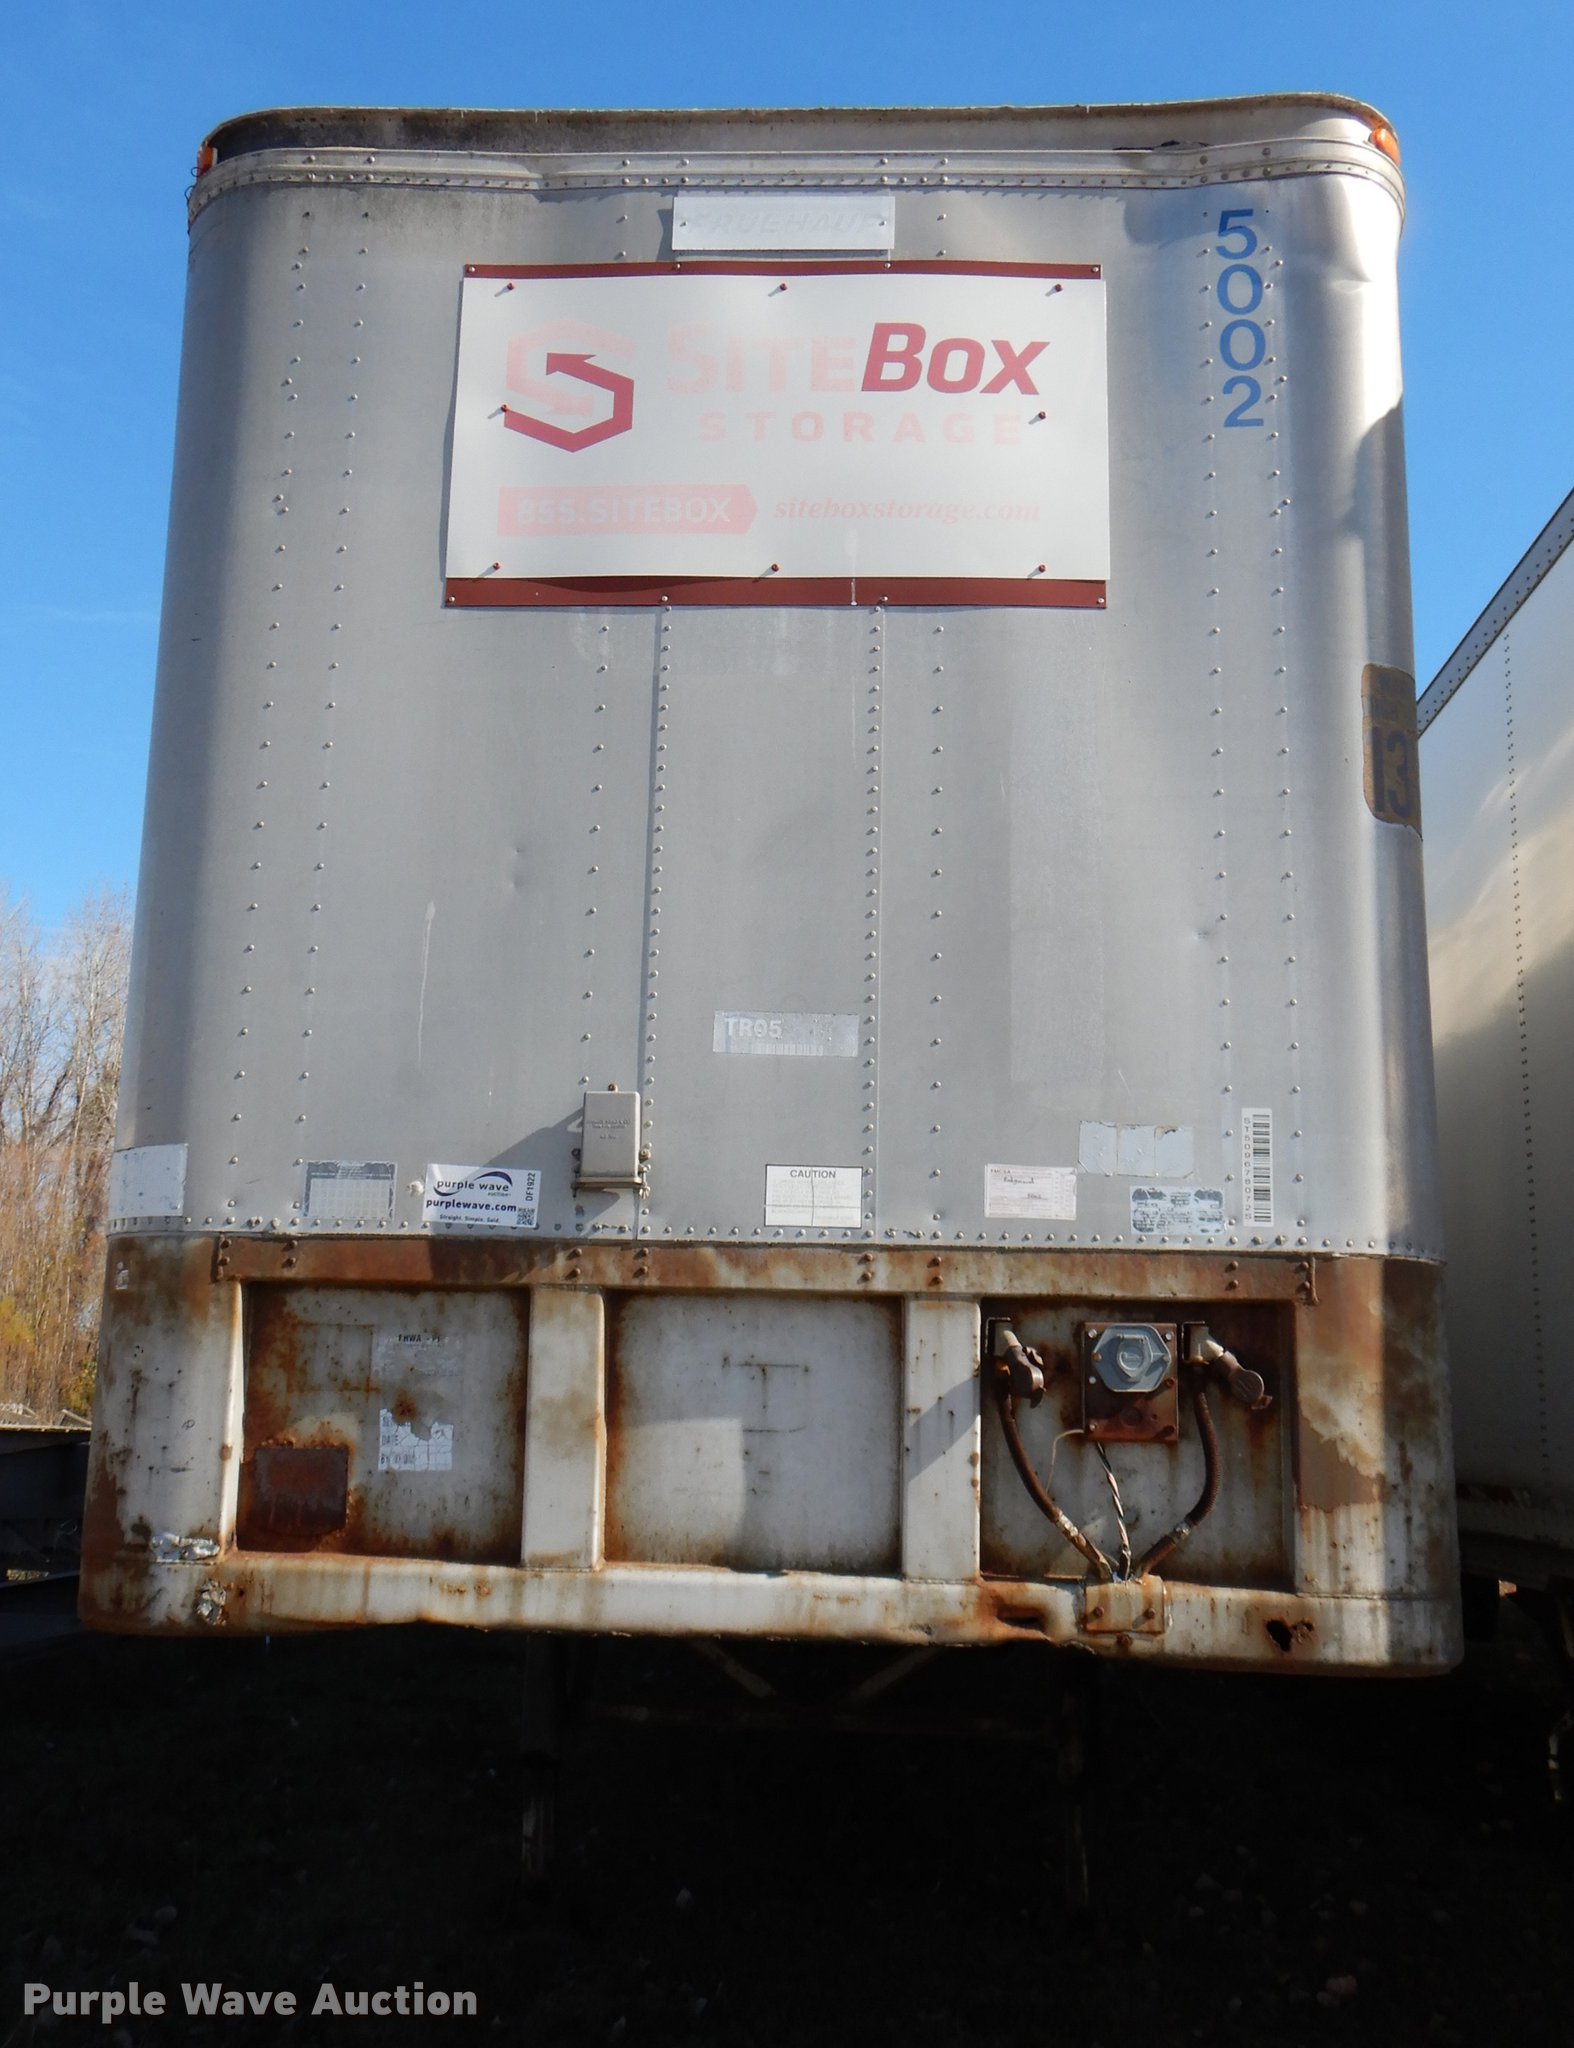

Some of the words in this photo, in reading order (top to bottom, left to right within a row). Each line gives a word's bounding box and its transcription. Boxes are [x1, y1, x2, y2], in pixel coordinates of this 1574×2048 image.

[1216, 209, 1266, 428] 5002
[699, 410, 1022, 445] STORAGE
[773, 494, 1042, 526] siteboxstorage.com
[437, 1180, 475, 1192] purple
[479, 1182, 510, 1192] wave
[525, 1172, 536, 1202] DF1922
[789, 1169, 837, 1179] CAUTION
[426, 1199, 517, 1213] purplewave.com
